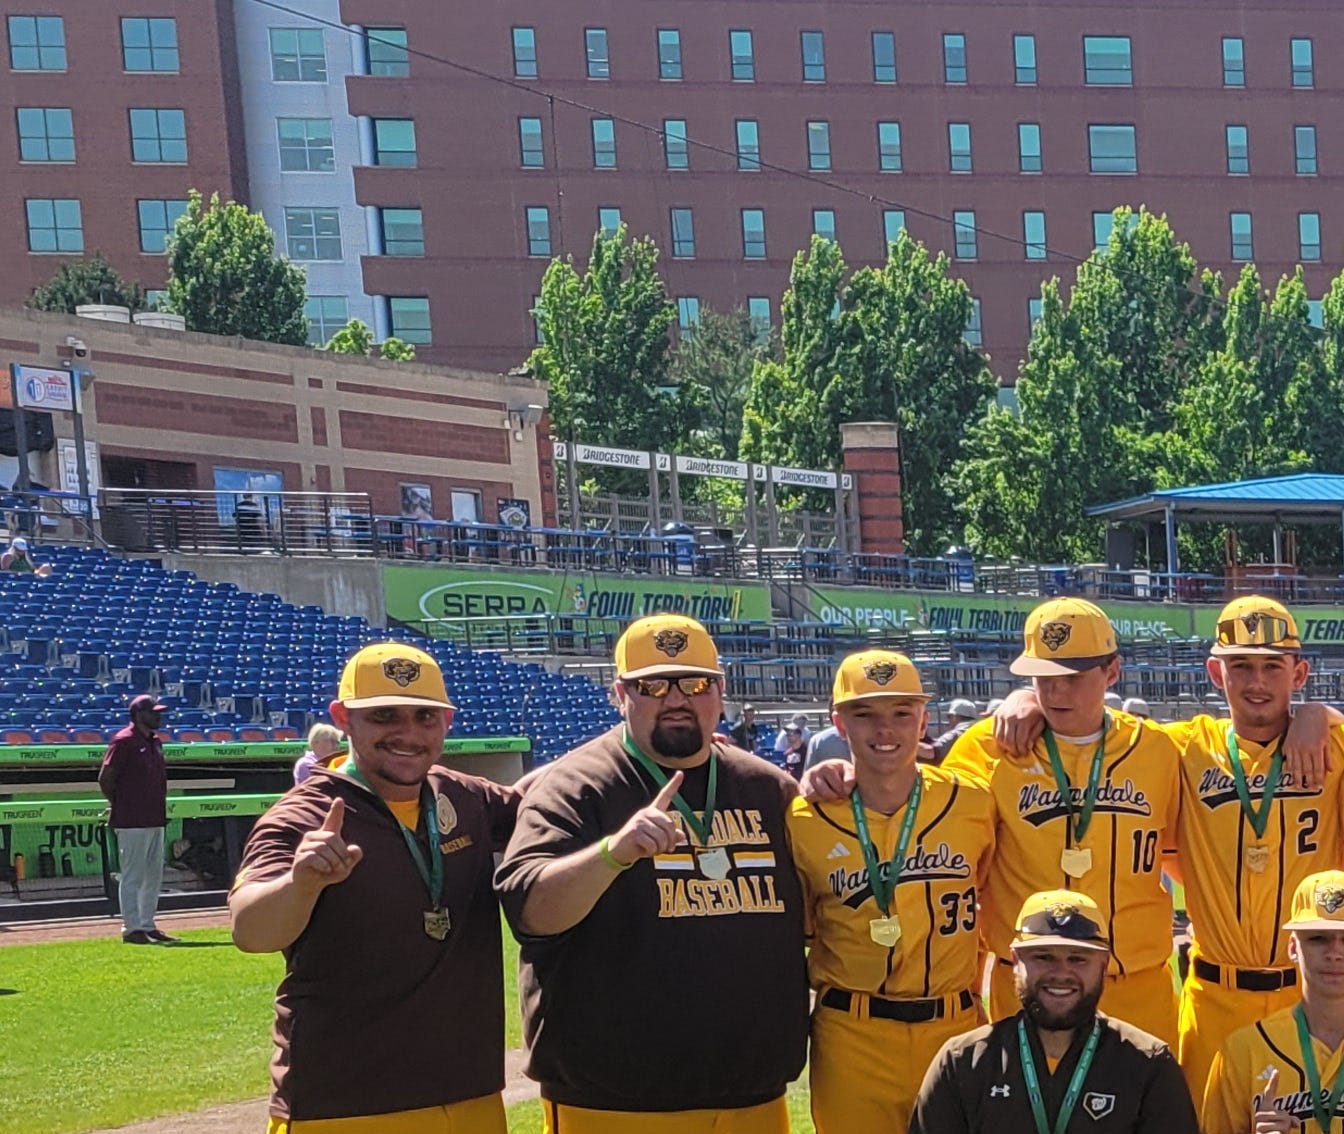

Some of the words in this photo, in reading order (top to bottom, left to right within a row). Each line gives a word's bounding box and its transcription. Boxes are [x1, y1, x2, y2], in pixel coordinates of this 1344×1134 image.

[582, 447, 641, 466] BRIDGESTONE
[685, 459, 739, 477] BRIDGESTONE
[780, 470, 829, 486] BRIDGESTONE
[443, 593, 546, 618] SERRA
[821, 608, 853, 624] OUR
[855, 608, 909, 628] PEOPLE
[968, 607, 1027, 631] TERRITOR
[1132, 620, 1168, 638] PLACE
[20, 750, 57, 759] TRUGREEN
[213, 748, 246, 756] TRUGREEN
[1018, 777, 1151, 815] Waydale
[3, 810, 43, 820] TRUGREEN
[200, 803, 234, 811] TRUGREEN
[1296, 807, 1320, 855] 2
[1131, 828, 1159, 875] 10
[829, 842, 971, 904] Wadale
[656, 875, 786, 918] BASEBALL
[939, 886, 978, 936] 33
